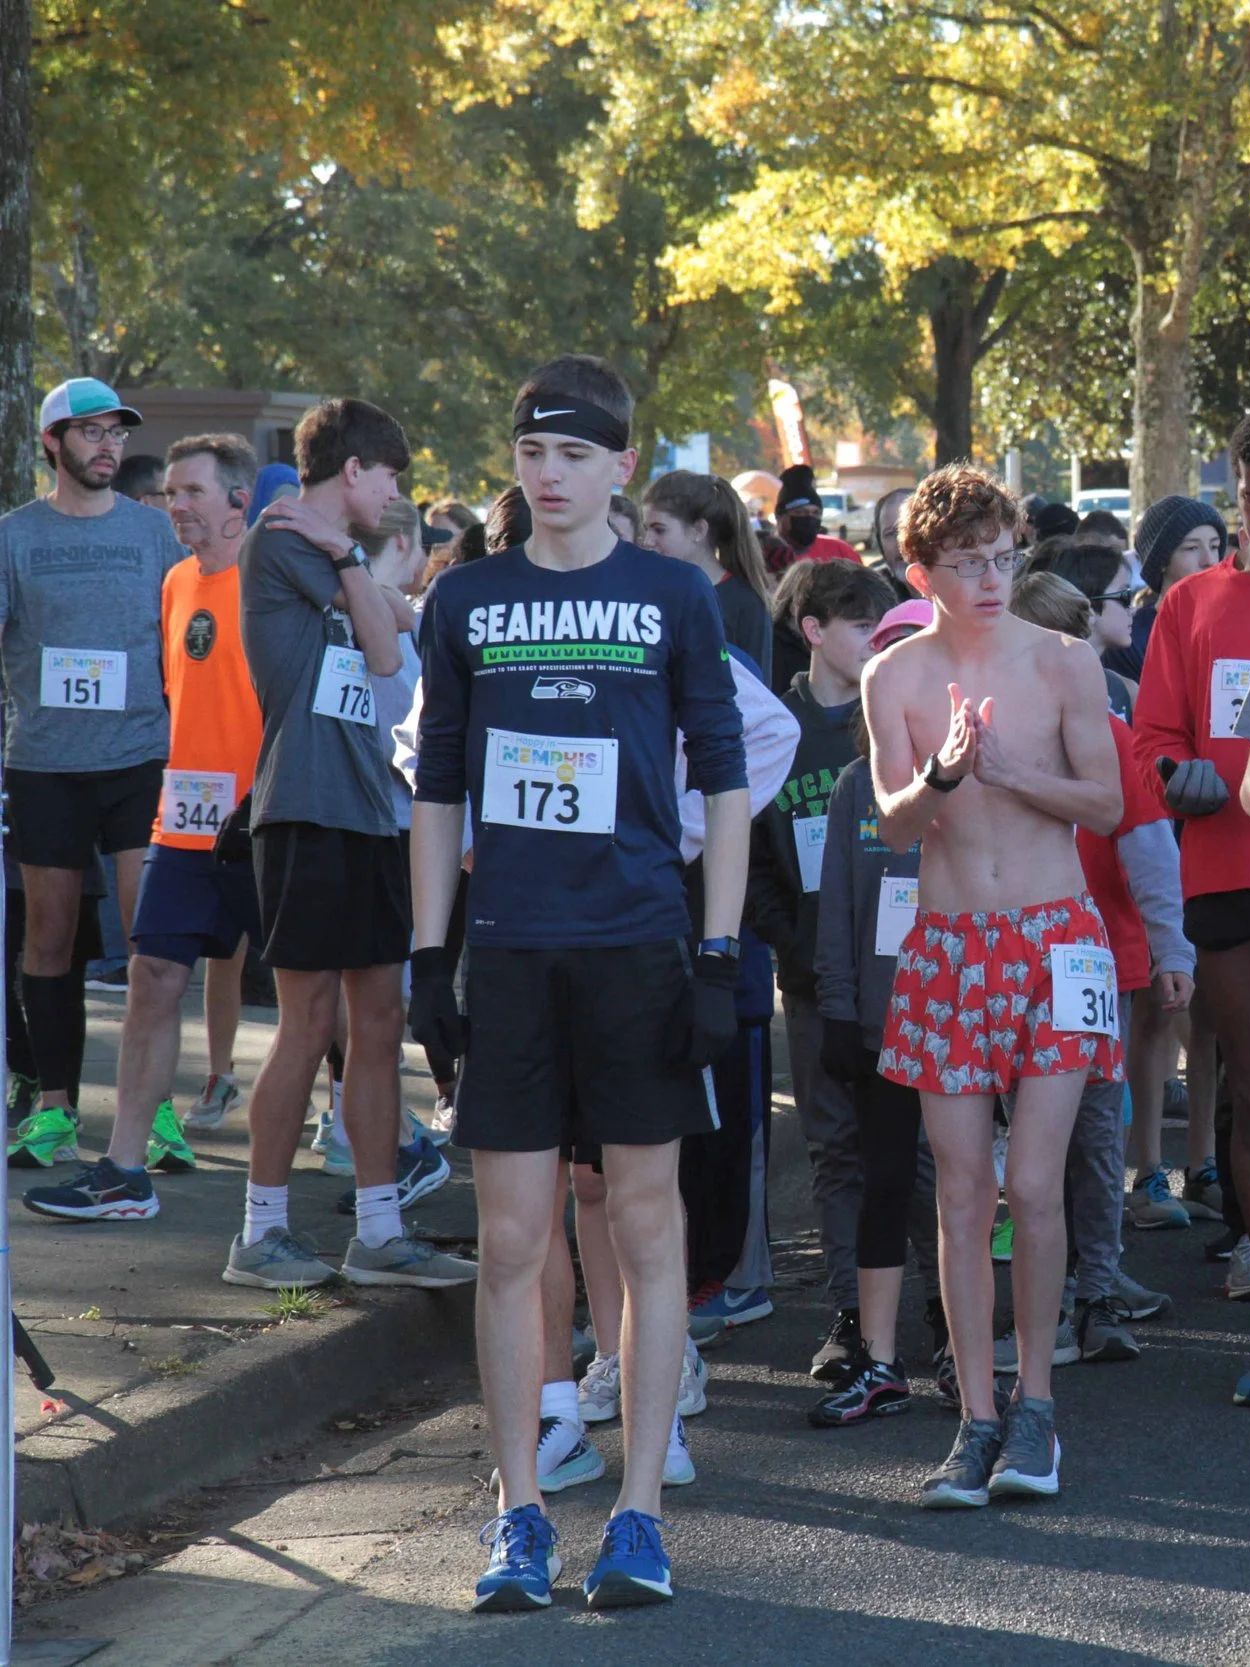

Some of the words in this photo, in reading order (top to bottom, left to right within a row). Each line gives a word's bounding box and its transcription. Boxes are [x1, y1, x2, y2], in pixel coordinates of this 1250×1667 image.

[468, 600, 662, 646] SEAHAWKS
[609, 665, 632, 673] SEATTLE
[63, 678, 100, 705] 151
[339, 684, 371, 719] 178
[502, 745, 598, 769] MEMPHIS
[513, 779, 580, 825] 173
[775, 767, 846, 813] SYCA
[174, 801, 220, 832] 344
[1081, 987, 1115, 1030] 314
